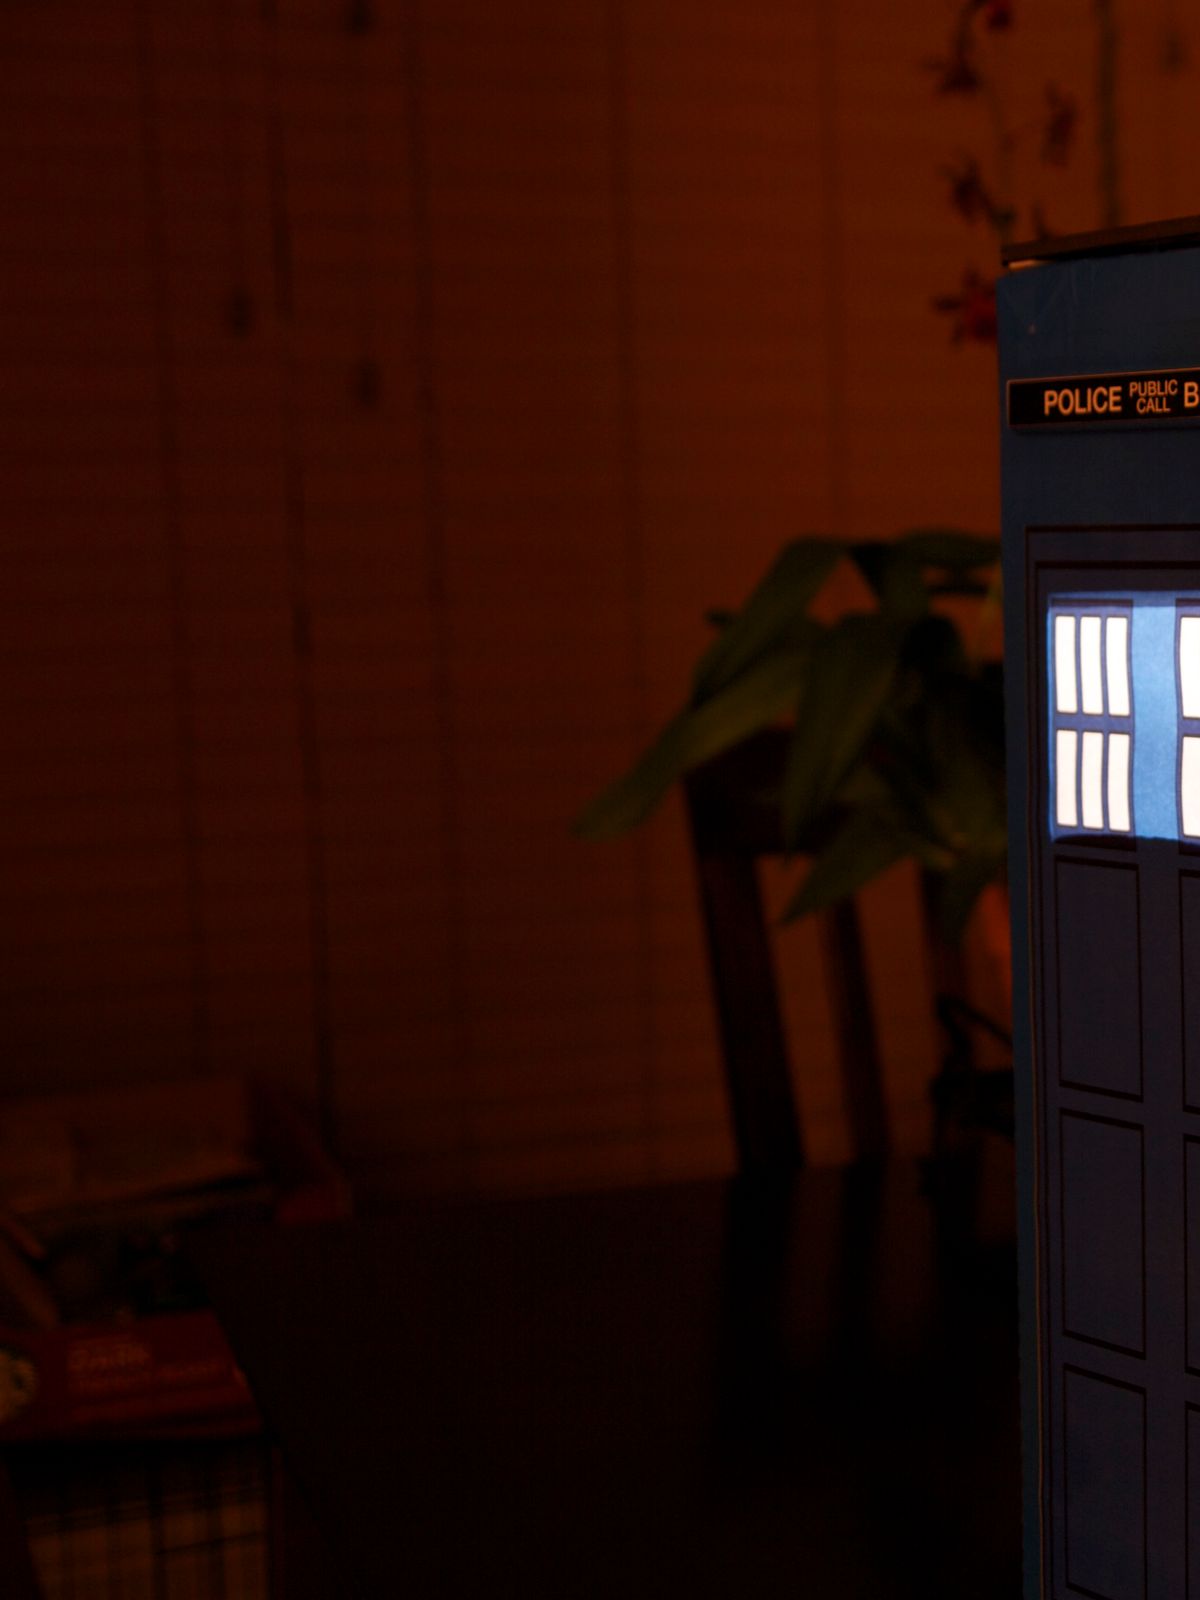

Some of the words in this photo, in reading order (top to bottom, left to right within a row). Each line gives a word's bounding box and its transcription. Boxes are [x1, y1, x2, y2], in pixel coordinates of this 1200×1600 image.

[1044, 386, 1122, 416] POLICE
[1129, 379, 1179, 398] PUBLIC
[1136, 397, 1171, 415] CALL
